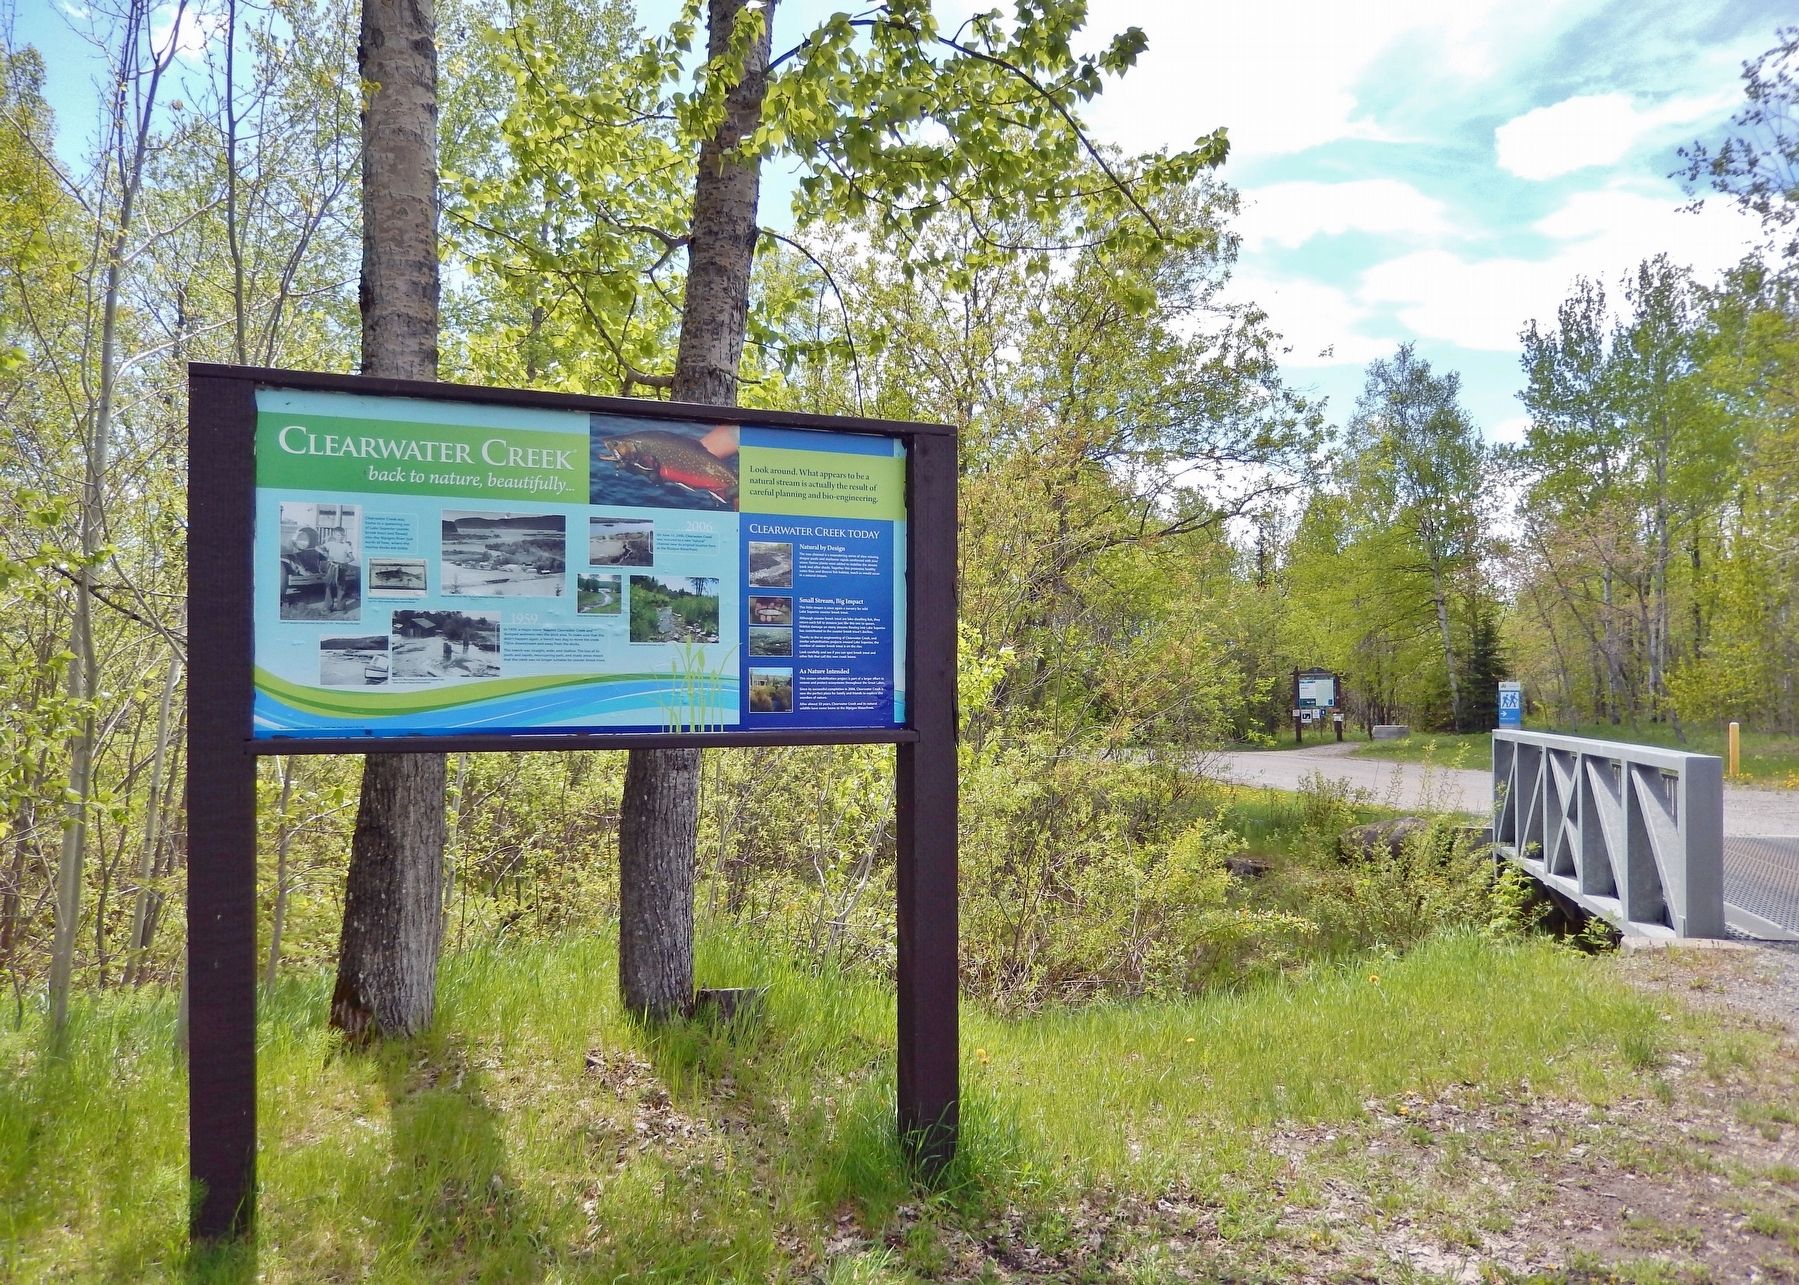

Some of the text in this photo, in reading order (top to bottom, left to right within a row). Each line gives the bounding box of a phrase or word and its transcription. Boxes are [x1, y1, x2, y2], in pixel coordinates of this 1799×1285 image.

[278, 425, 575, 471] CLEARWATER CREEK
[368, 465, 406, 482] back
[410, 469, 425, 483] to
[430, 472, 483, 489] nature,
[750, 465, 769, 474] Look
[770, 467, 798, 476] around.
[800, 468, 819, 478] What
[819, 471, 847, 480] appears
[776, 479, 800, 487] stream
[808, 480, 836, 490] actually
[836, 482, 848, 490] the
[849, 483, 868, 491] result
[869, 483, 877, 492] of
[749, 488, 775, 497] careful
[775, 489, 807, 500] planning
[808, 491, 821, 499] and
[750, 523, 880, 539] CLEARWATER CREEK TODAY
[799, 543, 819, 551] Natural
[827, 545, 846, 553] Design
